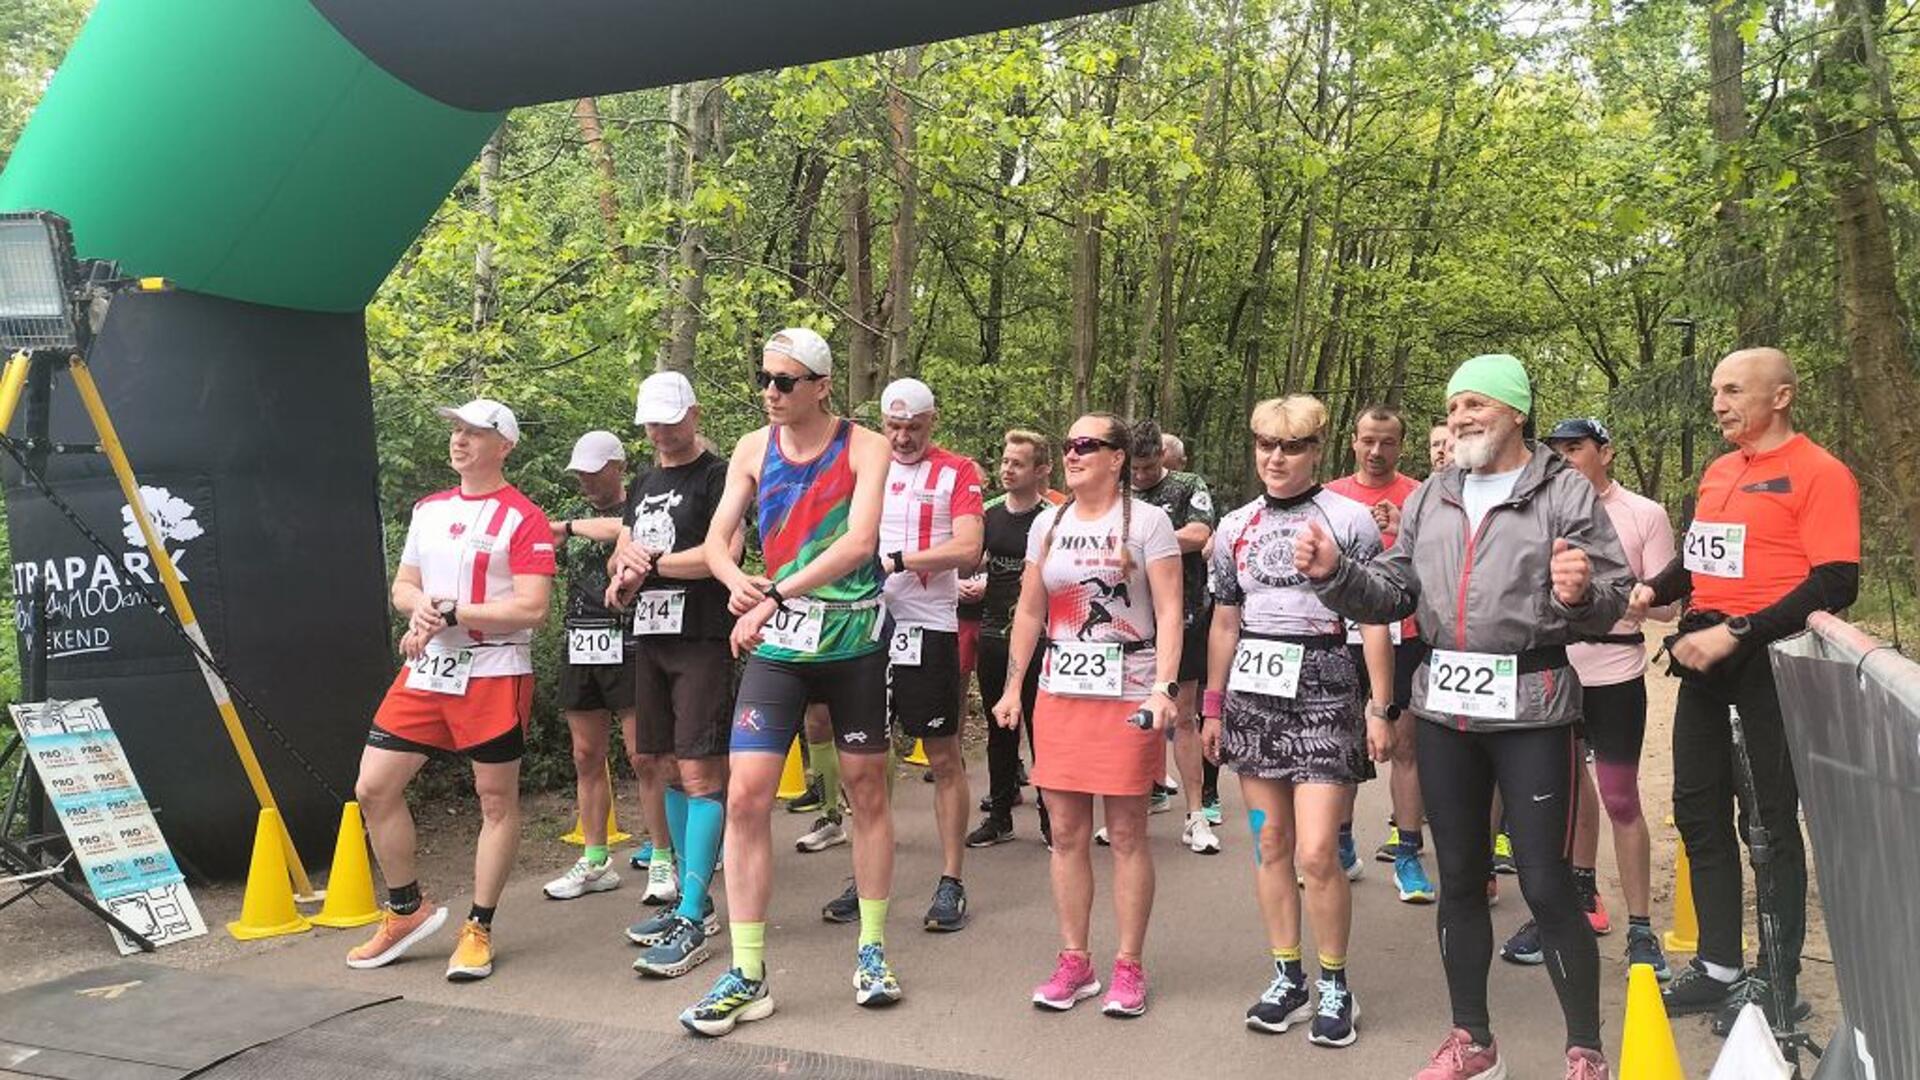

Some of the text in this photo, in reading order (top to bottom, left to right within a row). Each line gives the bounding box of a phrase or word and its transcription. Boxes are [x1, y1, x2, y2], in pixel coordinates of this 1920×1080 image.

[1688, 532, 1726, 560] 215
[638, 599, 670, 620] 214
[575, 633, 610, 652] 210
[417, 651, 457, 678] 212
[1058, 652, 1107, 677] 223
[1238, 650, 1285, 677] 216
[1438, 663, 1495, 696] 222
